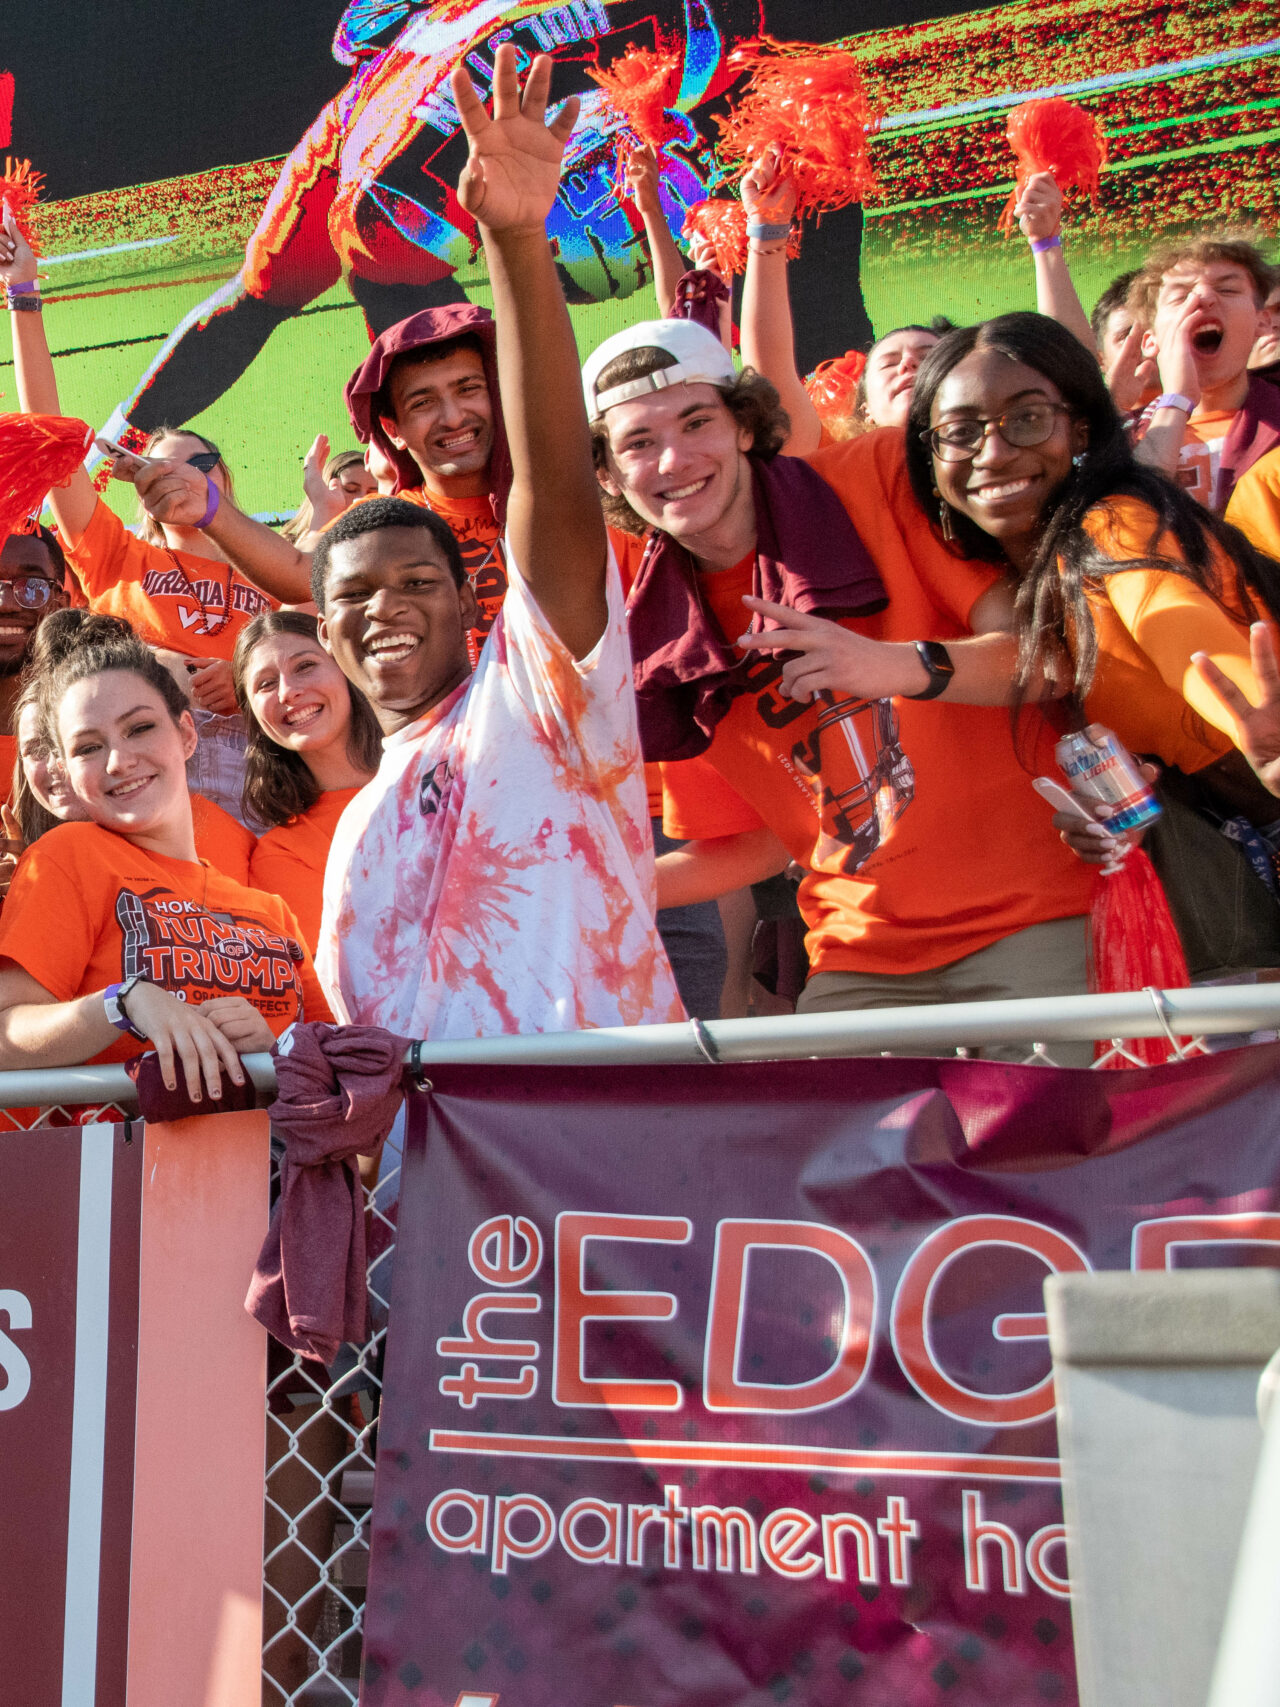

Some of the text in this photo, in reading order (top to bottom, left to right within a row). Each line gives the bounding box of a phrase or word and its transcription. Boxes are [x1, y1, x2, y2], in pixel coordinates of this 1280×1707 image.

[154, 900, 203, 914] HOK
[224, 944, 245, 957] OF
[436, 1211, 1280, 1428] the EDG
[426, 1484, 919, 1586] apartment
